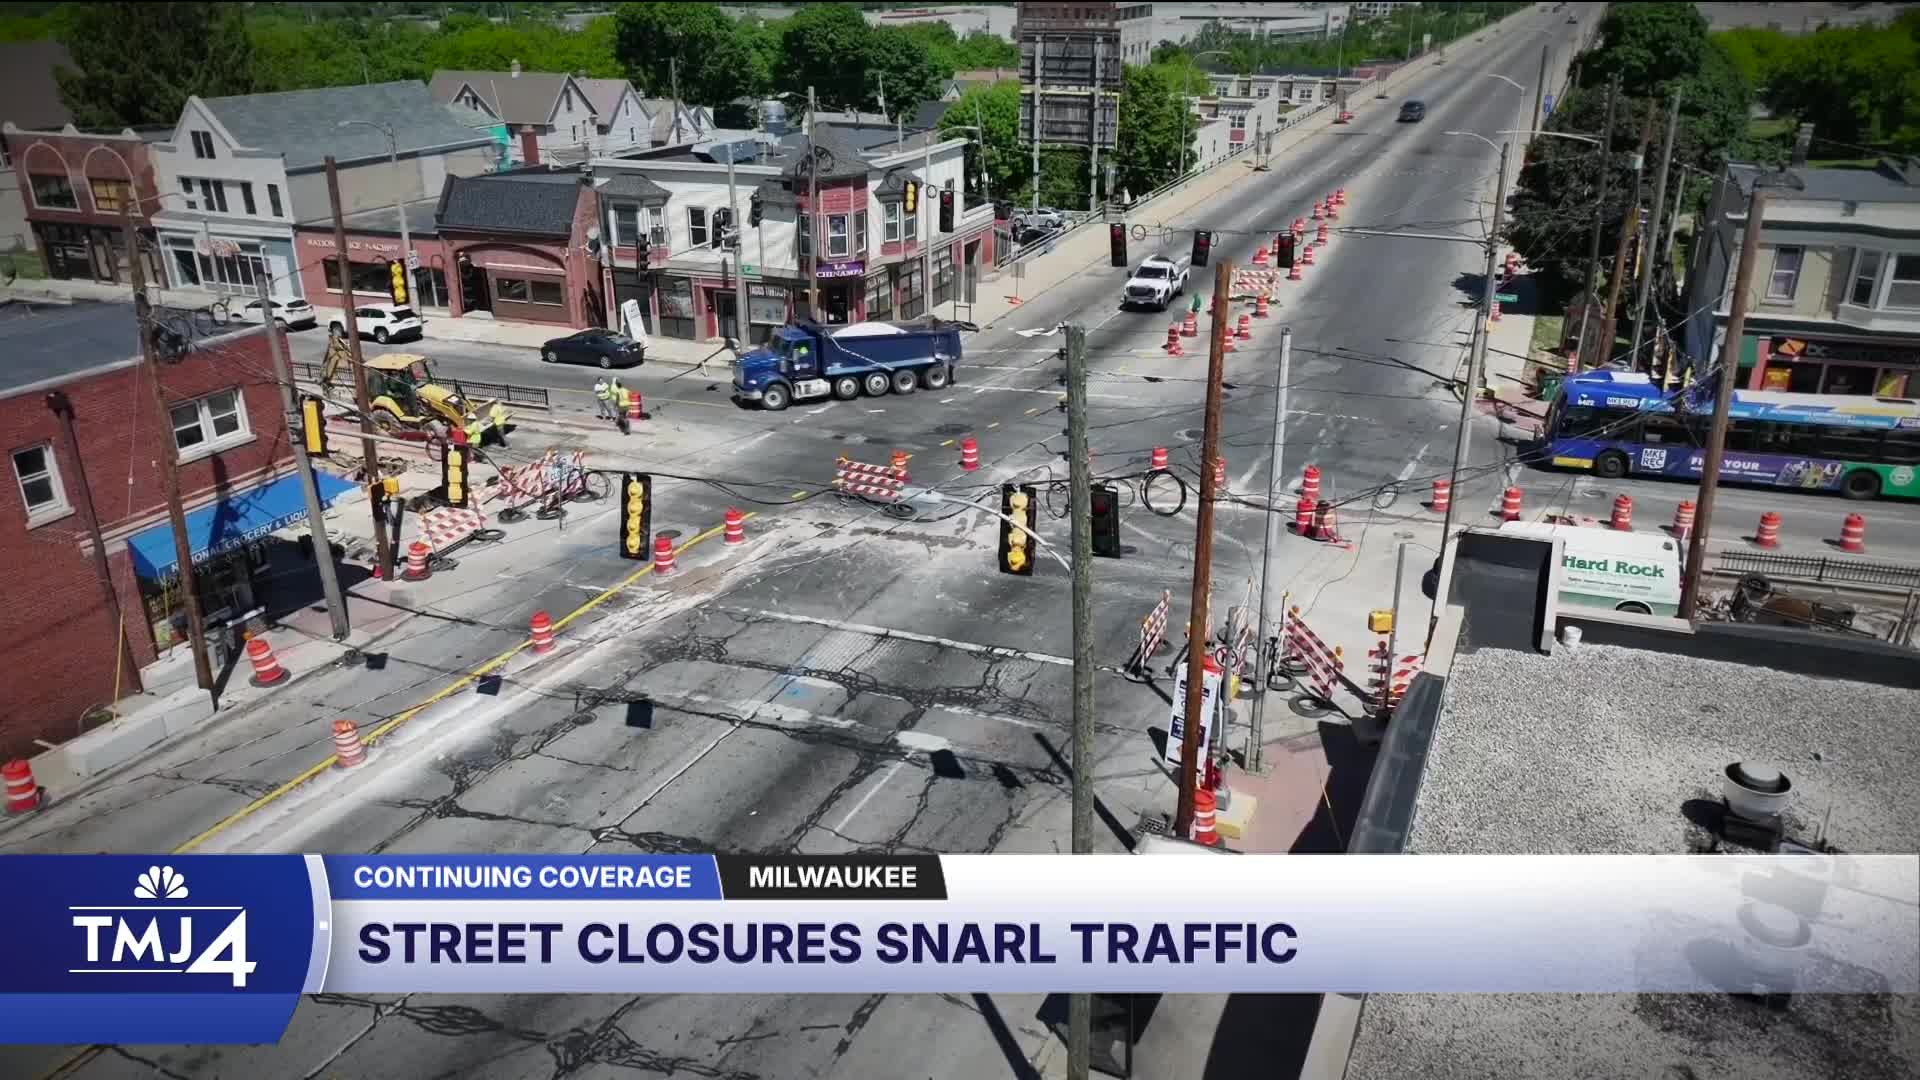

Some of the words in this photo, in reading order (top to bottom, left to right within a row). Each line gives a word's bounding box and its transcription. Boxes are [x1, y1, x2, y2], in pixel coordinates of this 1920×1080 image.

[816, 268, 863, 278] CHINAMPA
[1643, 449, 1665, 459] MKE
[1642, 458, 1664, 468] REC
[1724, 459, 1760, 471] YOUR
[171, 545, 223, 572] NIONAL
[225, 522, 273, 550] GROCERY
[275, 520, 282, 529] &
[1562, 555, 1609, 572] Hard
[1615, 560, 1665, 578] Rock
